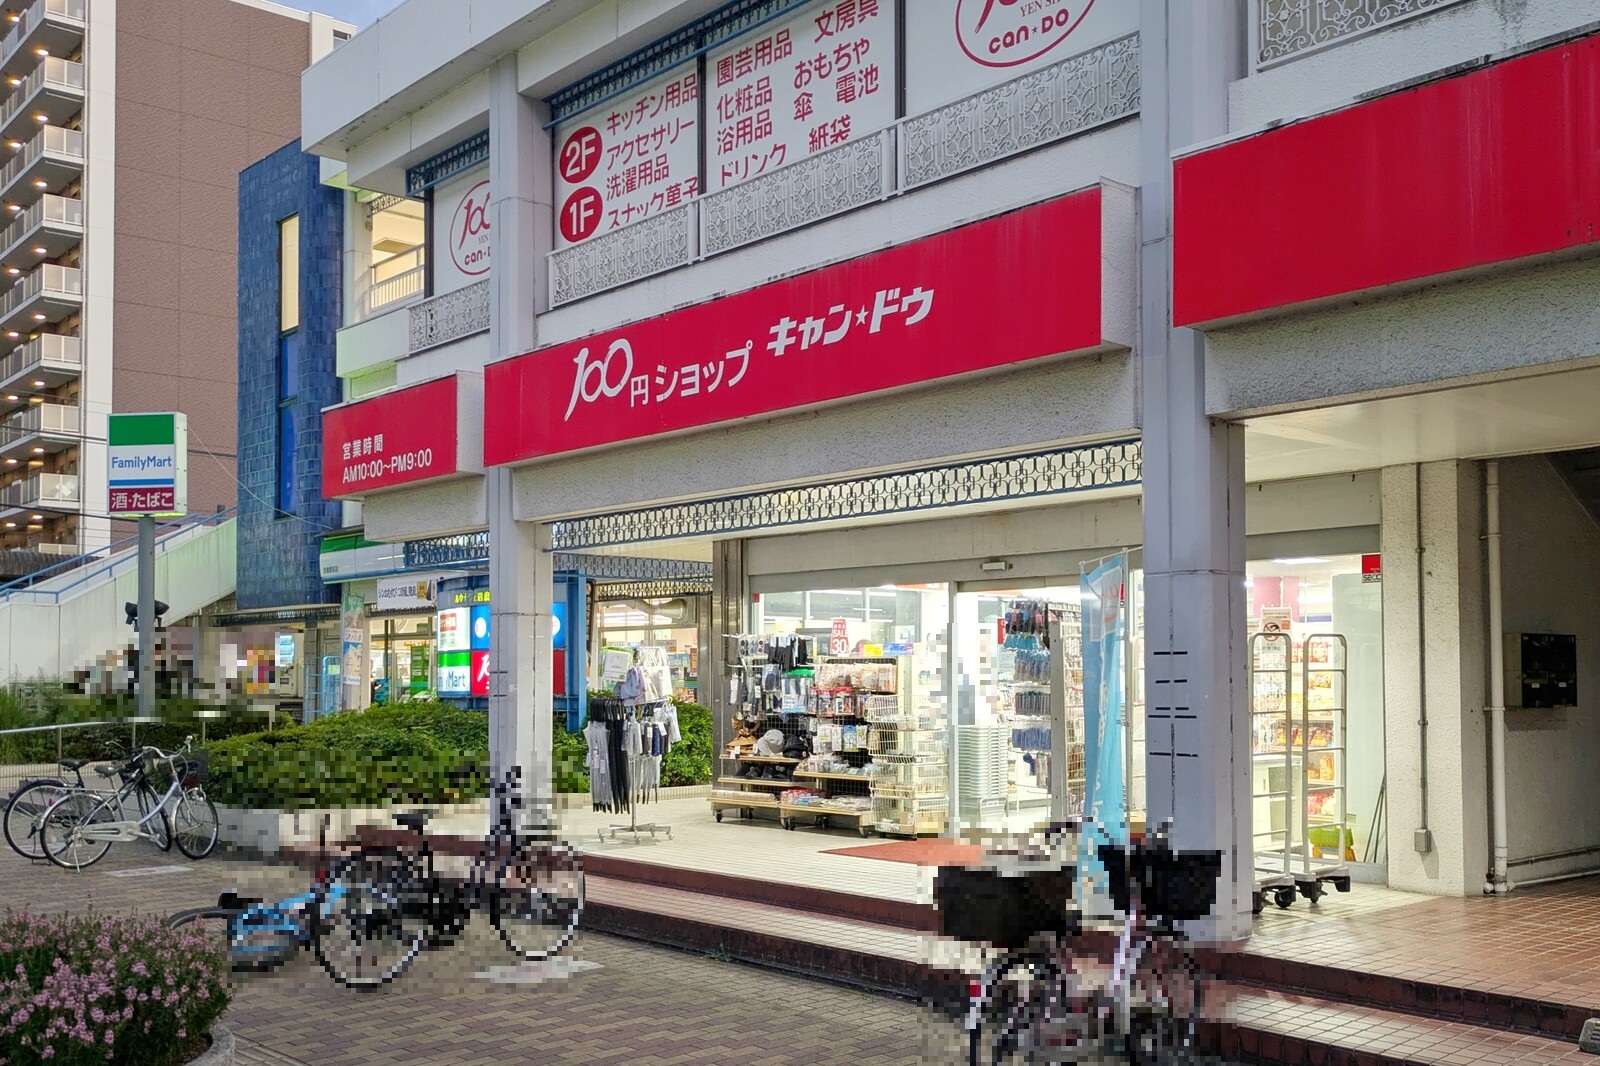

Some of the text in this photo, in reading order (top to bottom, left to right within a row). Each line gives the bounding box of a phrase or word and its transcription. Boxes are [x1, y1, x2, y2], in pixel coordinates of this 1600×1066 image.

[814, 0, 879, 43] 文房具
[717, 28, 792, 88] 園芸用品
[794, 37, 870, 90] おもちゃ
[606, 73, 699, 137] キッチン用品
[717, 76, 773, 124] 化粧品
[794, 64, 880, 122] 傘 電池
[566, 133, 596, 177] 2F
[607, 119, 696, 171] アクセサリー
[717, 108, 773, 156] 浴用品
[809, 114, 851, 153] 紙袋
[606, 153, 670, 201] 洗濯用品
[721, 143, 787, 187] ドリンク
[570, 194, 594, 235] 1F
[111, 455, 173, 471] FamilyMart
[342, 433, 384, 461] 営業時間
